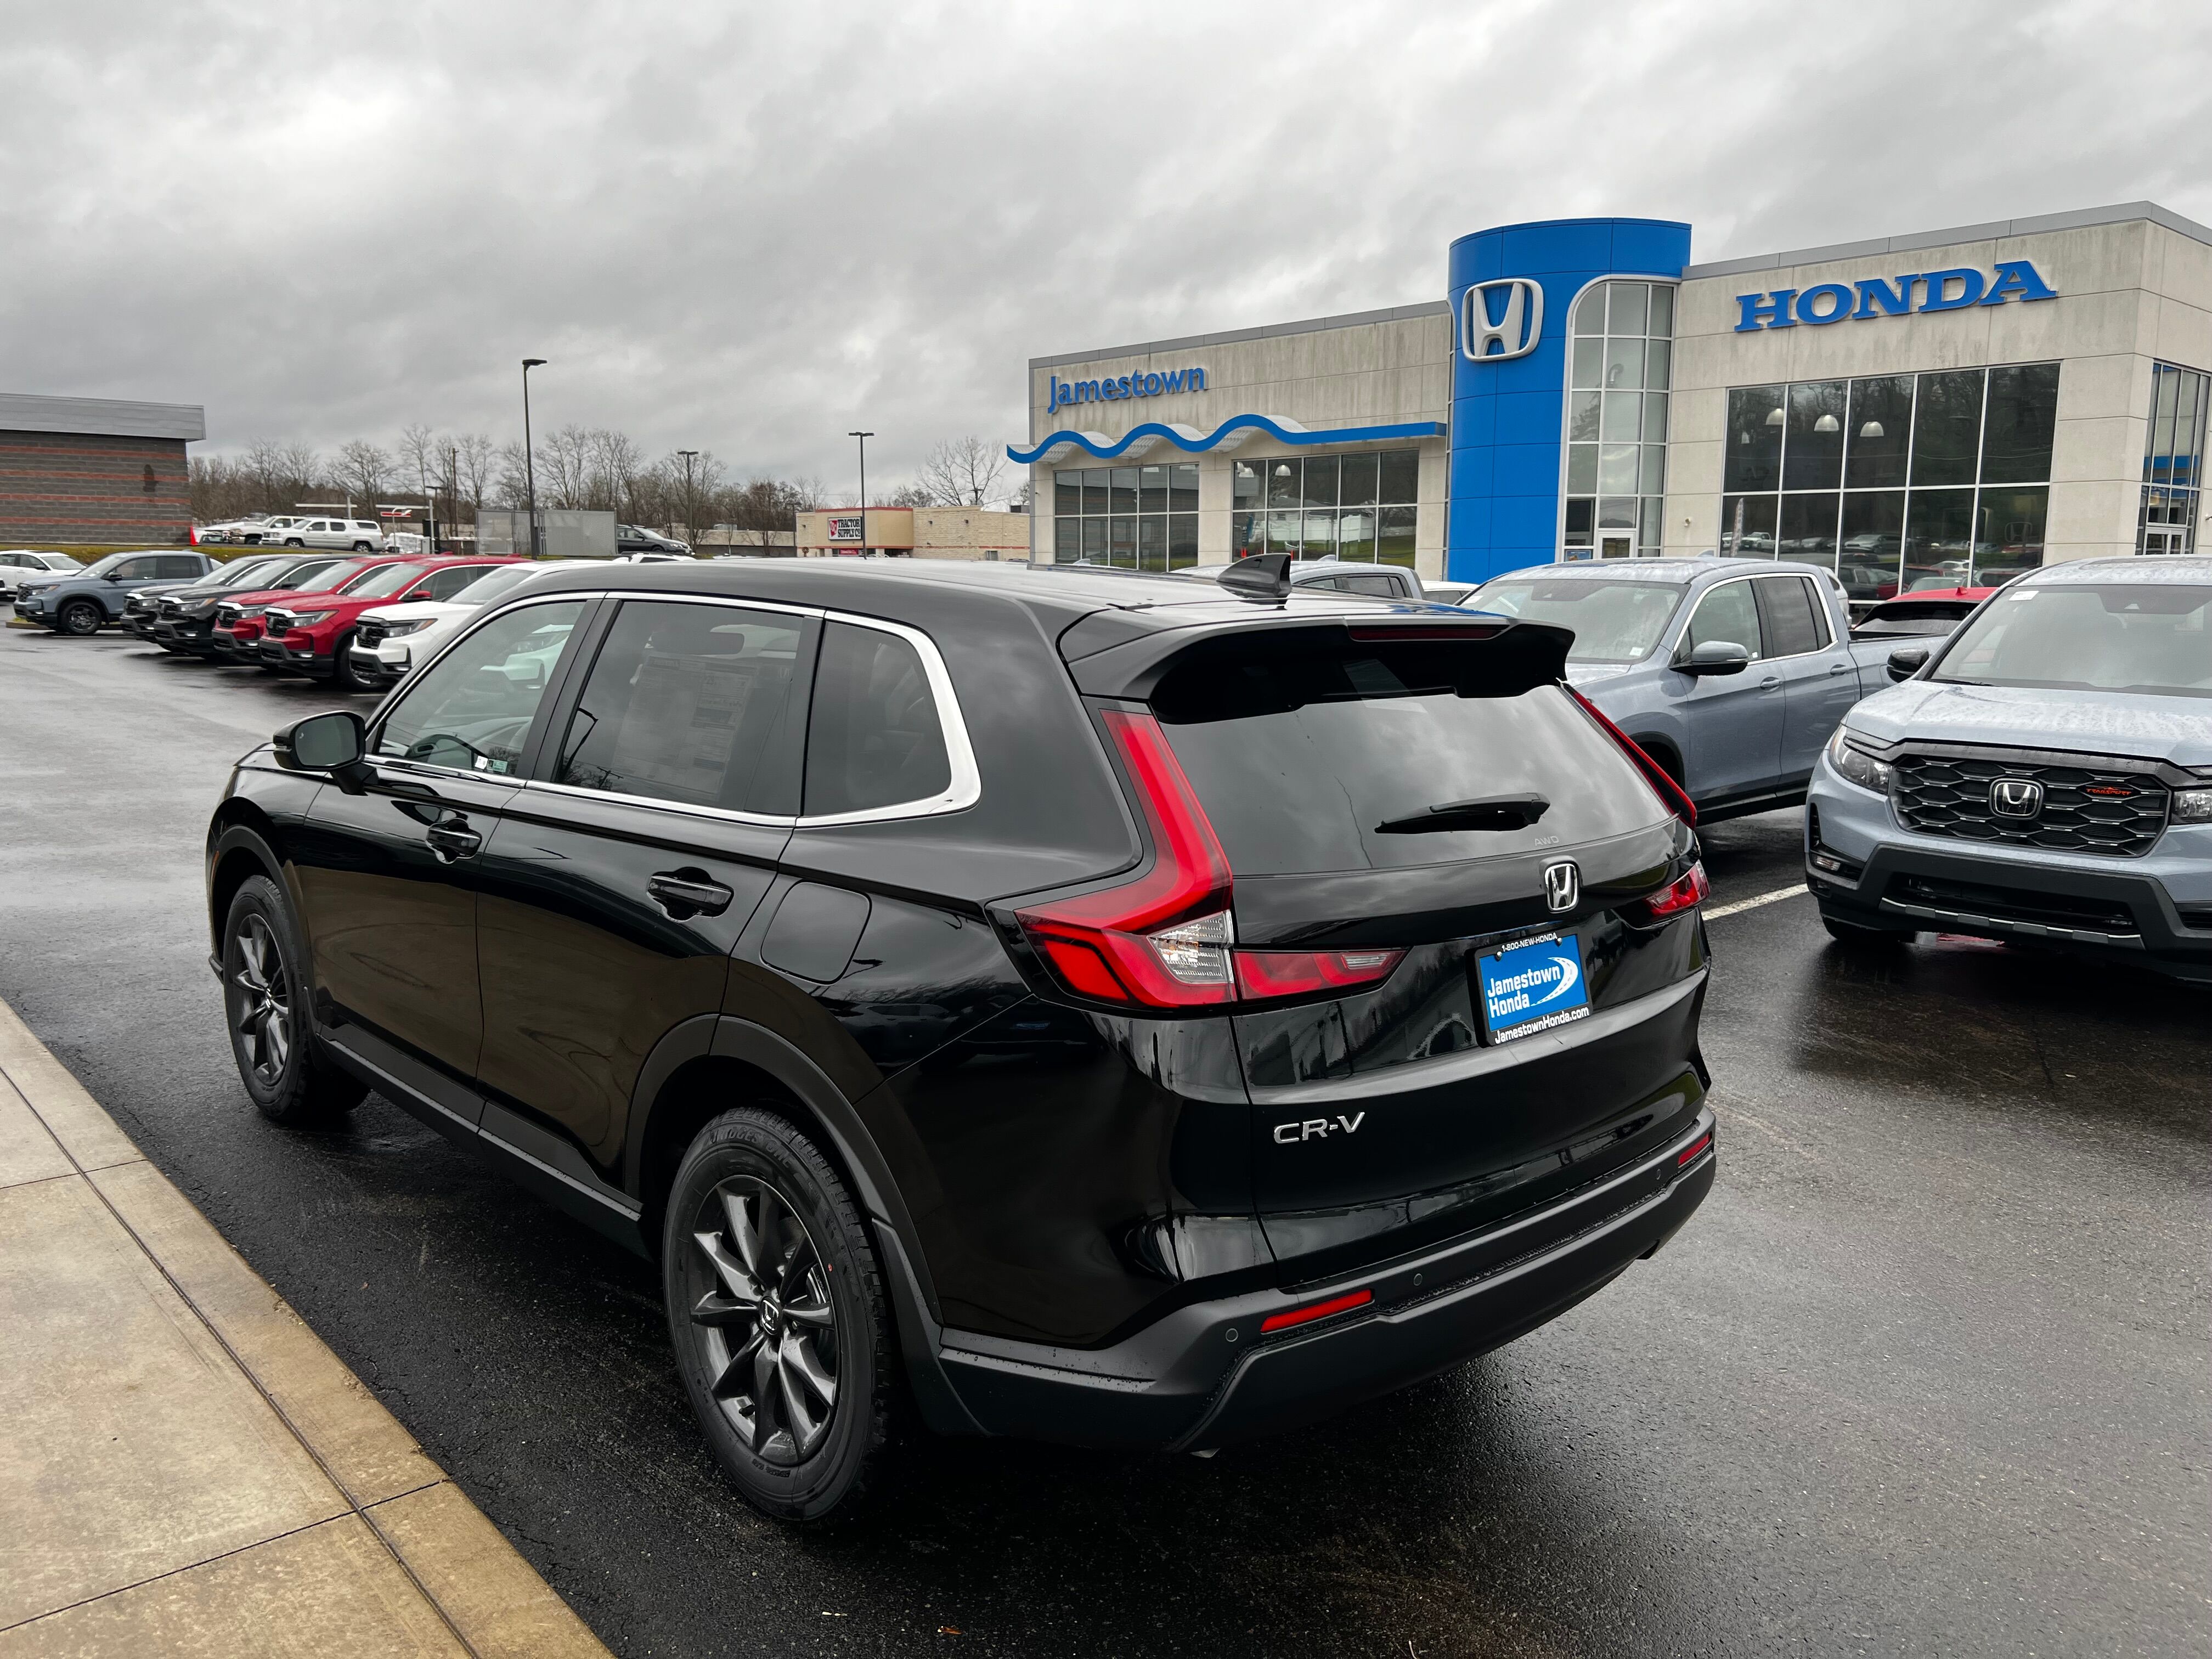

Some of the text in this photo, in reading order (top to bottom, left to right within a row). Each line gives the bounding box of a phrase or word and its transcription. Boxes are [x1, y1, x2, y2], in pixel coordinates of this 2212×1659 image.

[1734, 260, 2057, 332] HONDA
[1047, 367, 1207, 415] Jamestown
[837, 518, 860, 528] TRACTOR
[838, 528, 854, 537] SUPPLY
[1534, 836, 1559, 847] AWD
[1502, 932, 1558, 952] 1-800-NEW-HONDA
[1487, 966, 1561, 997] Jamestown
[1488, 990, 1530, 1018] Honda
[1494, 1006, 1589, 1045] JamestownHonda.com
[1273, 1111, 1365, 1144] CR-V
